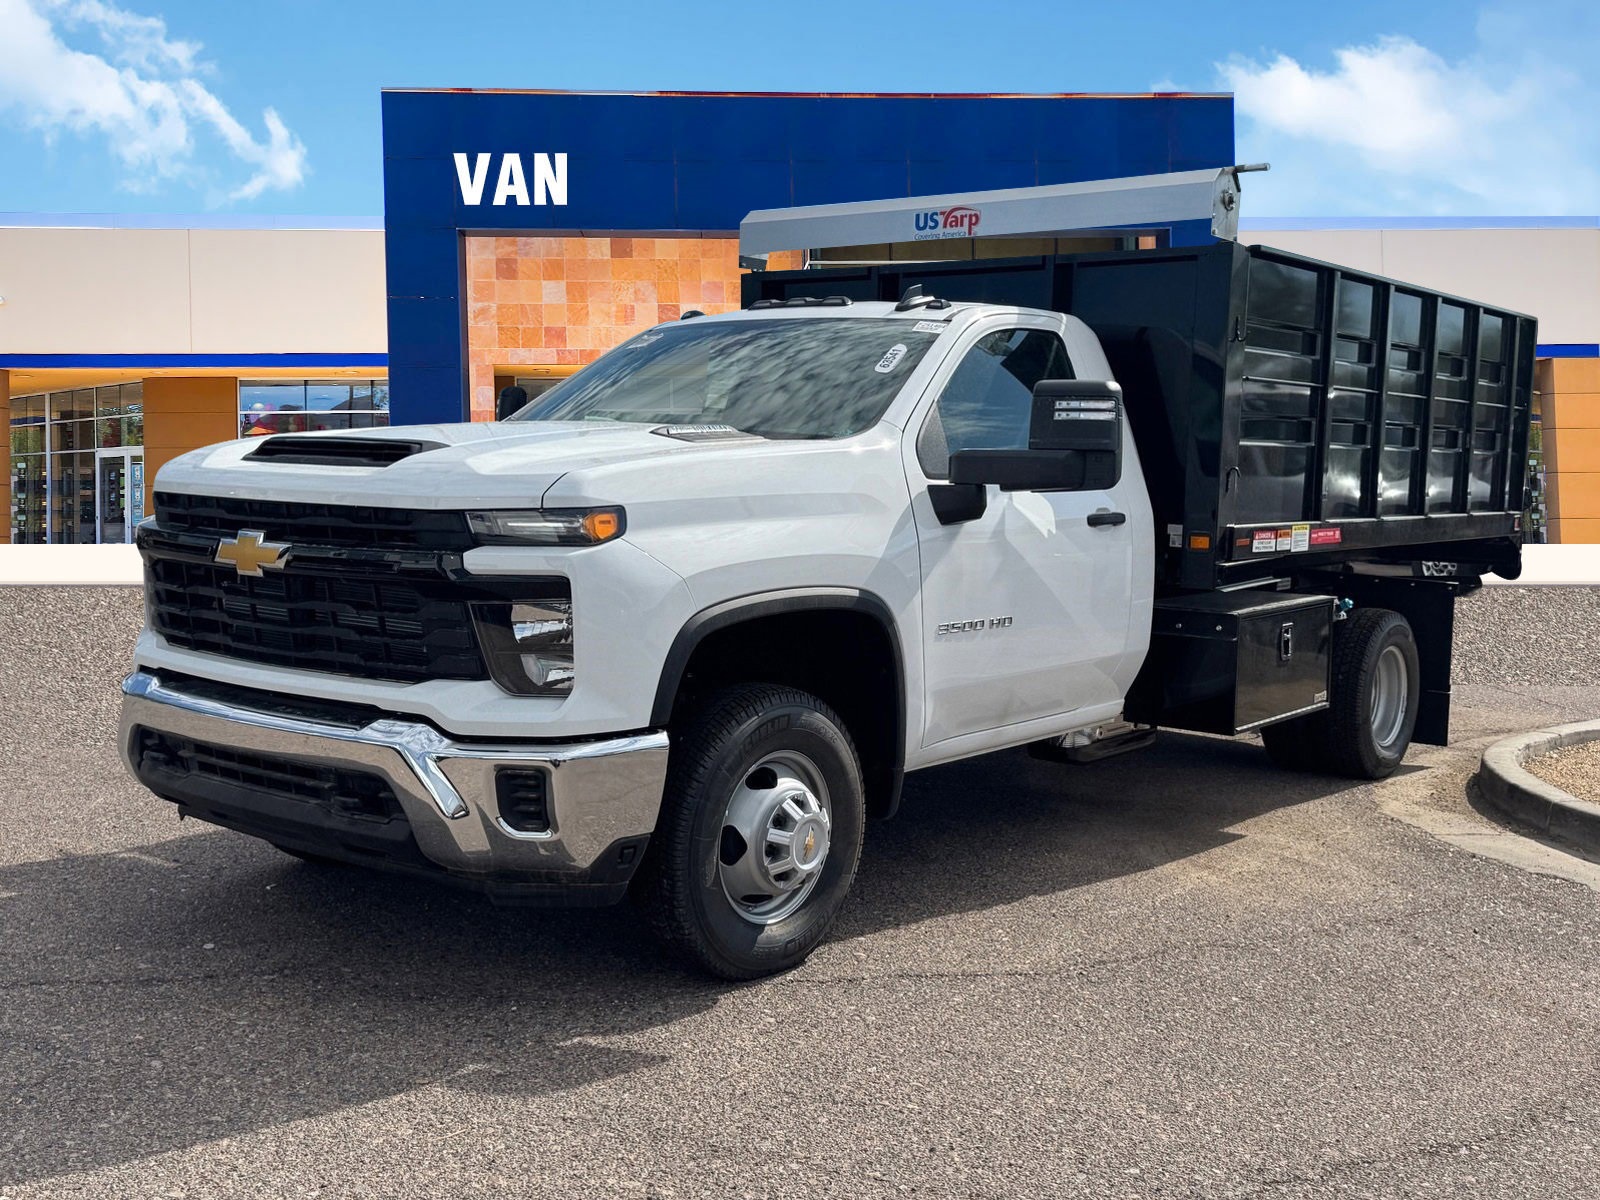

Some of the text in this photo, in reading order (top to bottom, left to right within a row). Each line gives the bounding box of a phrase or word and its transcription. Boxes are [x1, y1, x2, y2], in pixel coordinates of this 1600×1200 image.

[453, 152, 568, 206] VAN
[914, 230, 967, 241] Covering America
[937, 615, 1014, 636] 3500 HD
